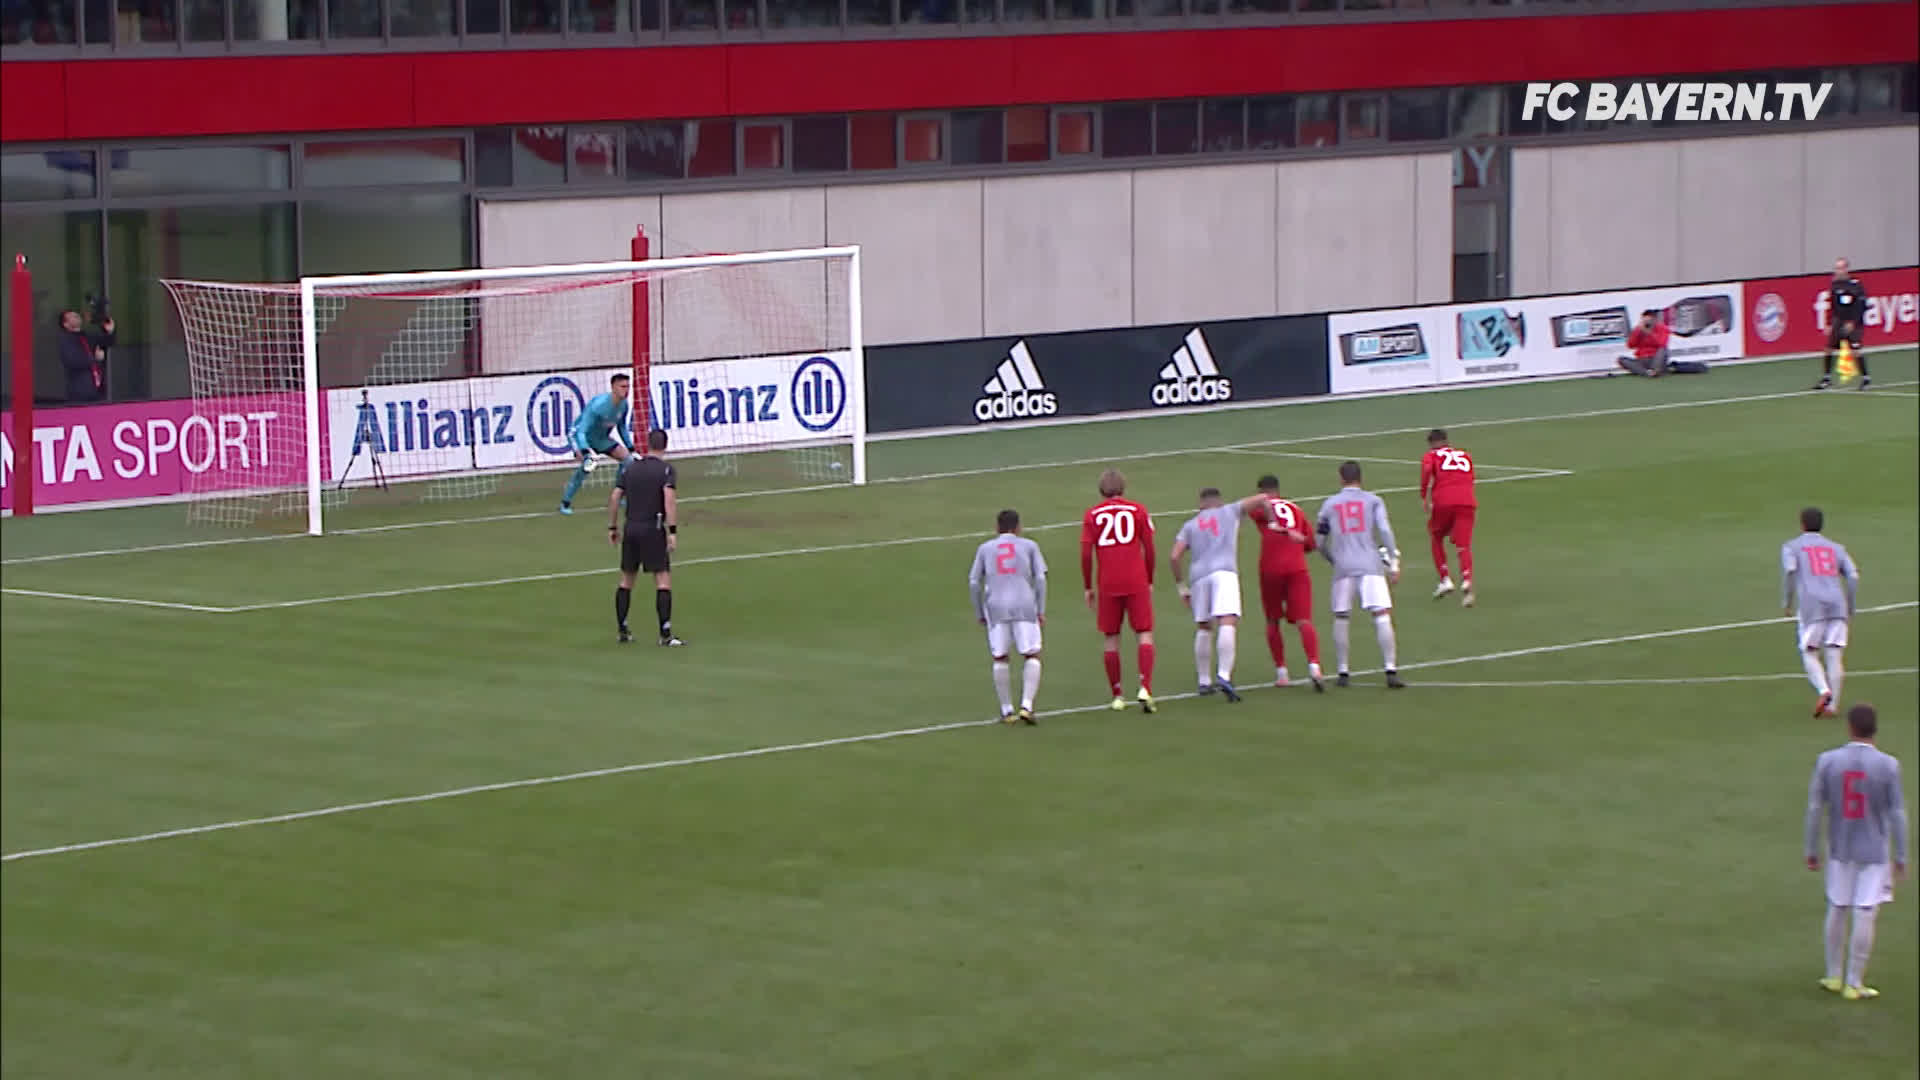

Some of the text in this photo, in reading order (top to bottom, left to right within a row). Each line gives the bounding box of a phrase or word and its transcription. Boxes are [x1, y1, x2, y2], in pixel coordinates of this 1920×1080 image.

[975, 391, 1057, 420] adidas
[1152, 377, 1231, 404] adidas
[355, 399, 515, 455] Allianz
[112, 411, 278, 479] SPORT
[1437, 447, 1471, 472] 25
[1095, 510, 1136, 546] 20
[1196, 516, 1220, 536] 4
[1274, 502, 1296, 529] 9
[1332, 501, 1366, 534] 19
[996, 541, 1017, 575] 2
[1802, 546, 1838, 576] 18
[1842, 771, 1866, 819] 6
